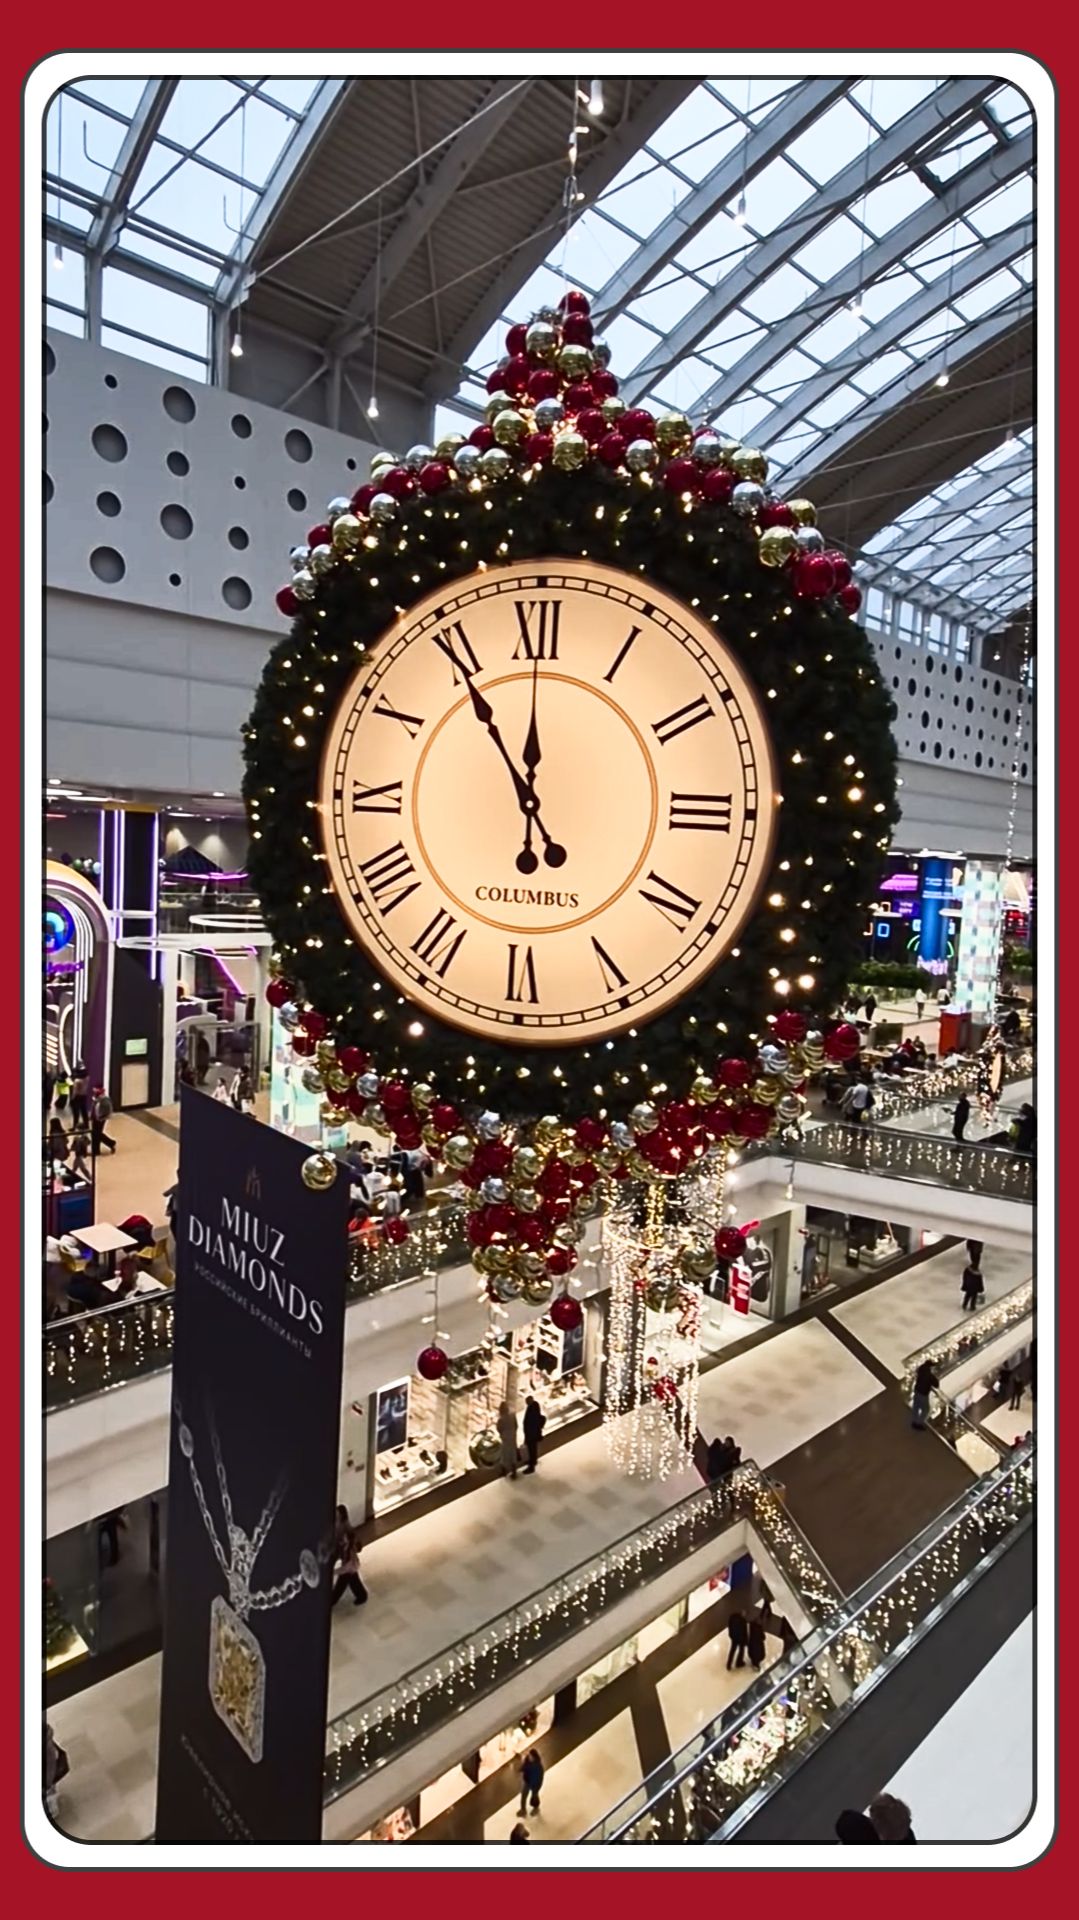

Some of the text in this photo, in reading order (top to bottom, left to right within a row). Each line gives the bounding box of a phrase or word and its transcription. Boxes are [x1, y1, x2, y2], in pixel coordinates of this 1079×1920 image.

[432, 621, 483, 685] XI
[512, 600, 561, 660] XII
[603, 626, 642, 682] I
[372, 694, 425, 739] X
[651, 694, 714, 745] II
[352, 780, 402, 814] IX
[669, 792, 732, 833] III
[358, 841, 422, 917] VIII
[475, 886, 579, 908] COLUMBUS
[638, 871, 702, 932] IV
[410, 908, 467, 978] VII
[591, 936, 629, 993] V
[504, 944, 539, 1004] VI
[221, 1197, 286, 1267] MIUZ
[189, 1215, 324, 1335] DIAMONDS
